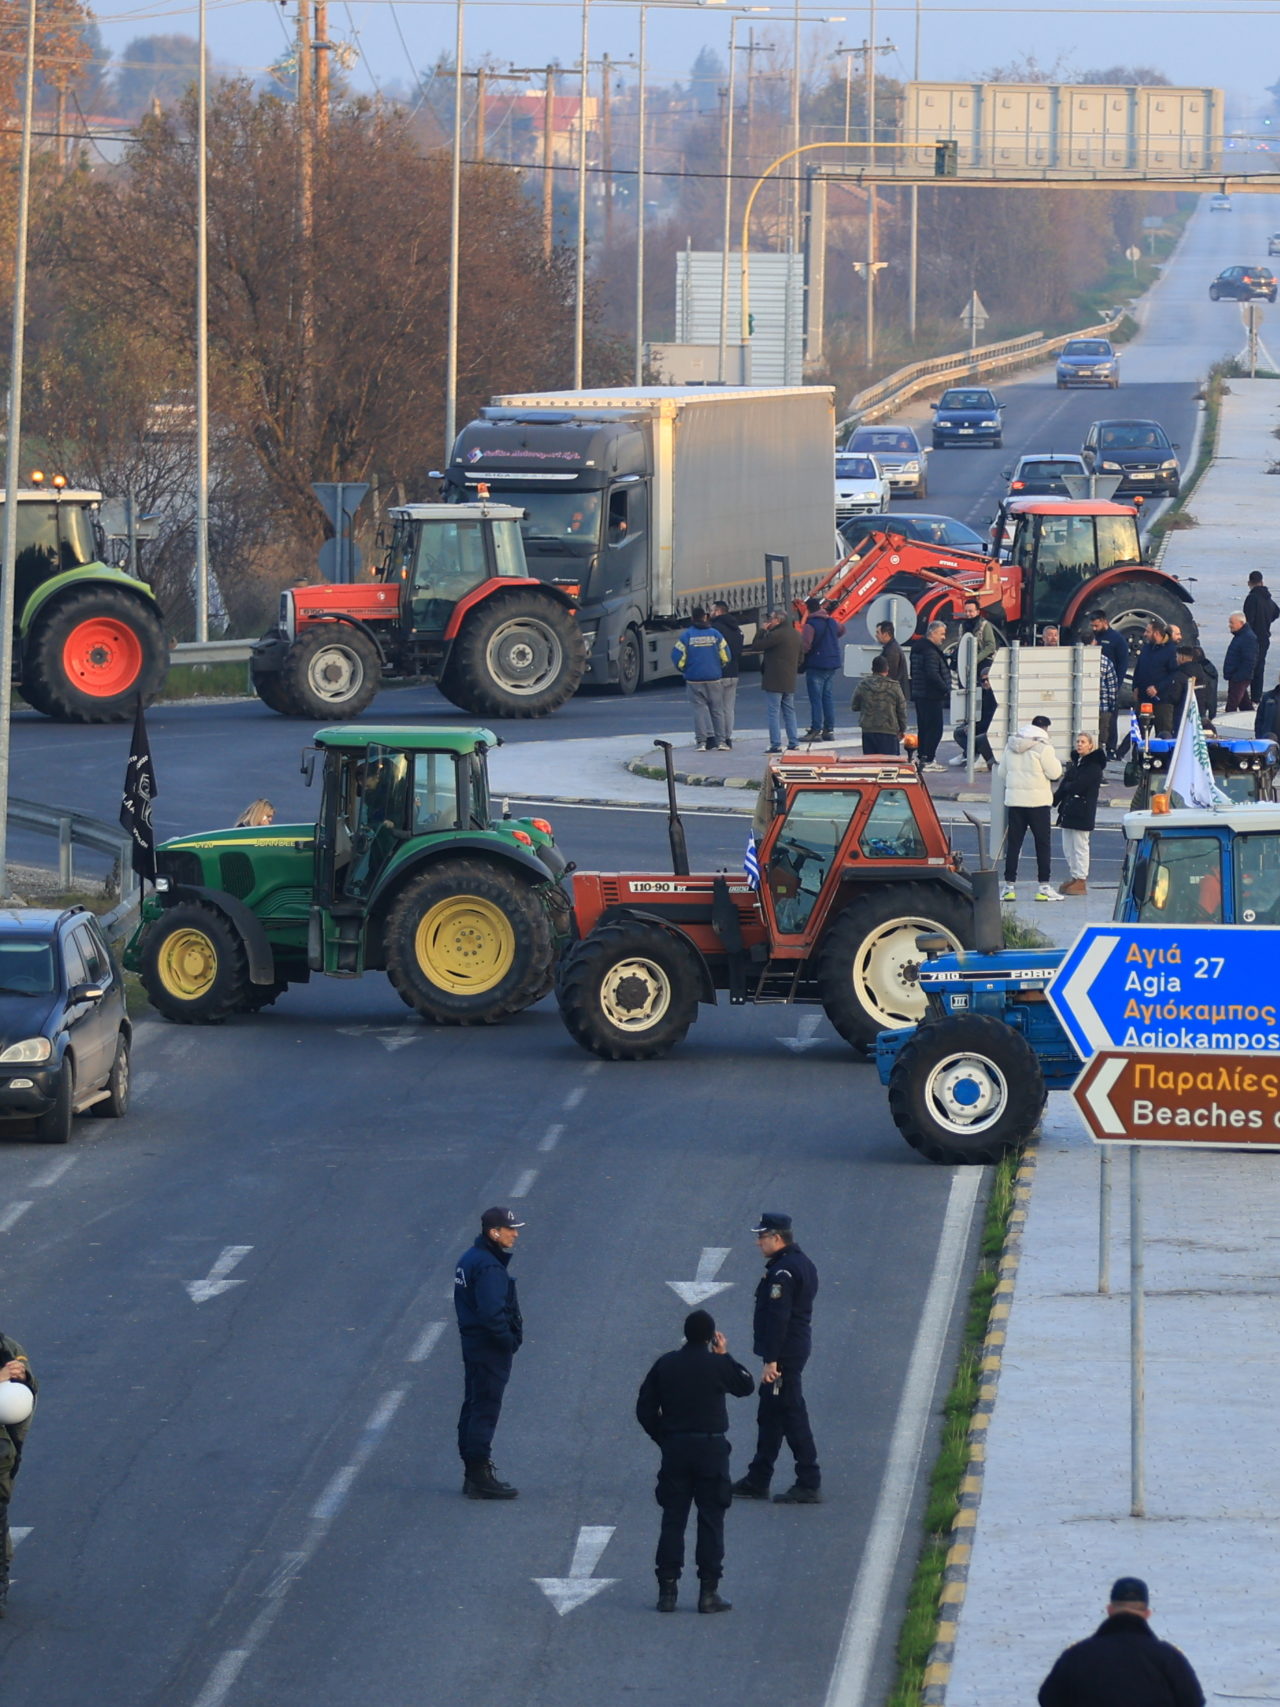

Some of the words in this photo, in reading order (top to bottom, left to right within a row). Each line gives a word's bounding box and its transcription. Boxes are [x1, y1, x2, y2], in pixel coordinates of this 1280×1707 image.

[633, 882, 670, 892] 110-90
[1125, 943, 1182, 968] Αγιά
[1194, 957, 1225, 979] 27
[930, 972, 960, 980] 7810
[1011, 969, 1054, 979] FORD
[1124, 970, 1181, 997] Agia
[1123, 998, 1277, 1026] Αγιόκαμπος
[1122, 1026, 1280, 1050] Agiokampos
[1134, 1063, 1279, 1098] Παραλίες
[1132, 1100, 1263, 1128] Beaches
